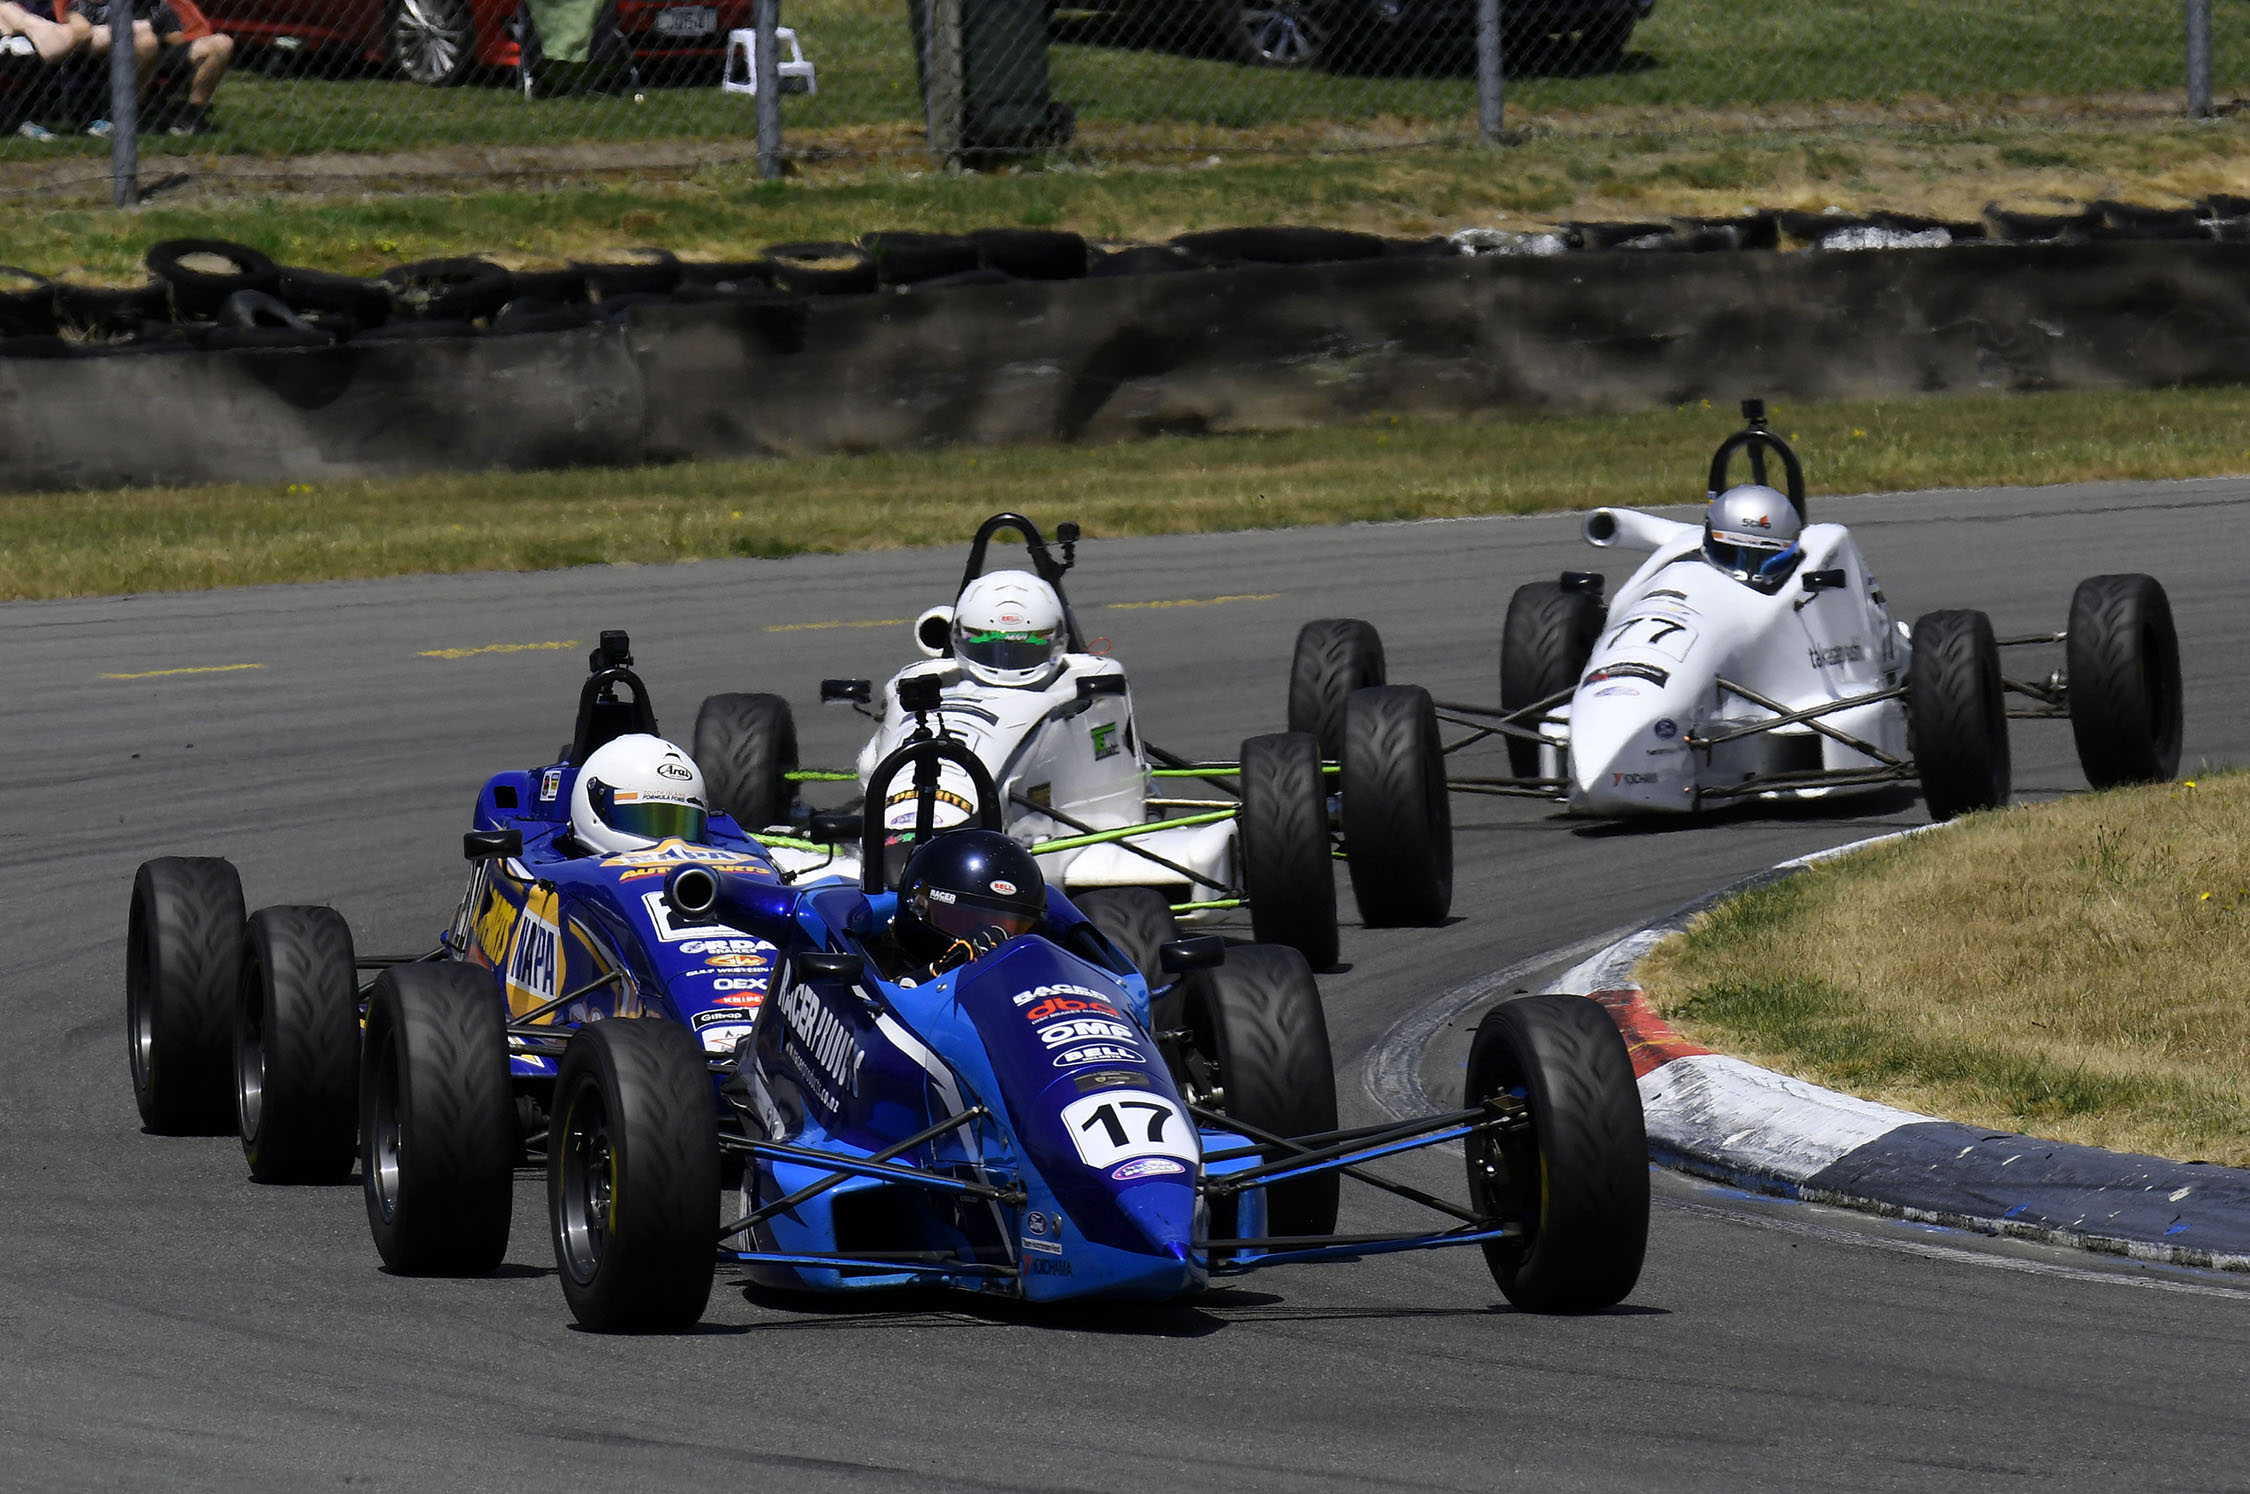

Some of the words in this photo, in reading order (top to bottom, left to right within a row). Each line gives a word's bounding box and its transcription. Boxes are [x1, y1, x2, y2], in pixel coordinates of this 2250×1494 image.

[664, 764, 690, 778] Arai
[994, 882, 1013, 892] BELL
[509, 915, 556, 997] NAPA
[713, 978, 768, 990] OEX
[723, 995, 764, 1004] KNIPE
[777, 957, 821, 1048] RACER
[701, 1012, 743, 1022] Giltrap
[1041, 1022, 1133, 1043] OMP
[1064, 1046, 1136, 1062] BELL
[1081, 1101, 1174, 1148] 17
